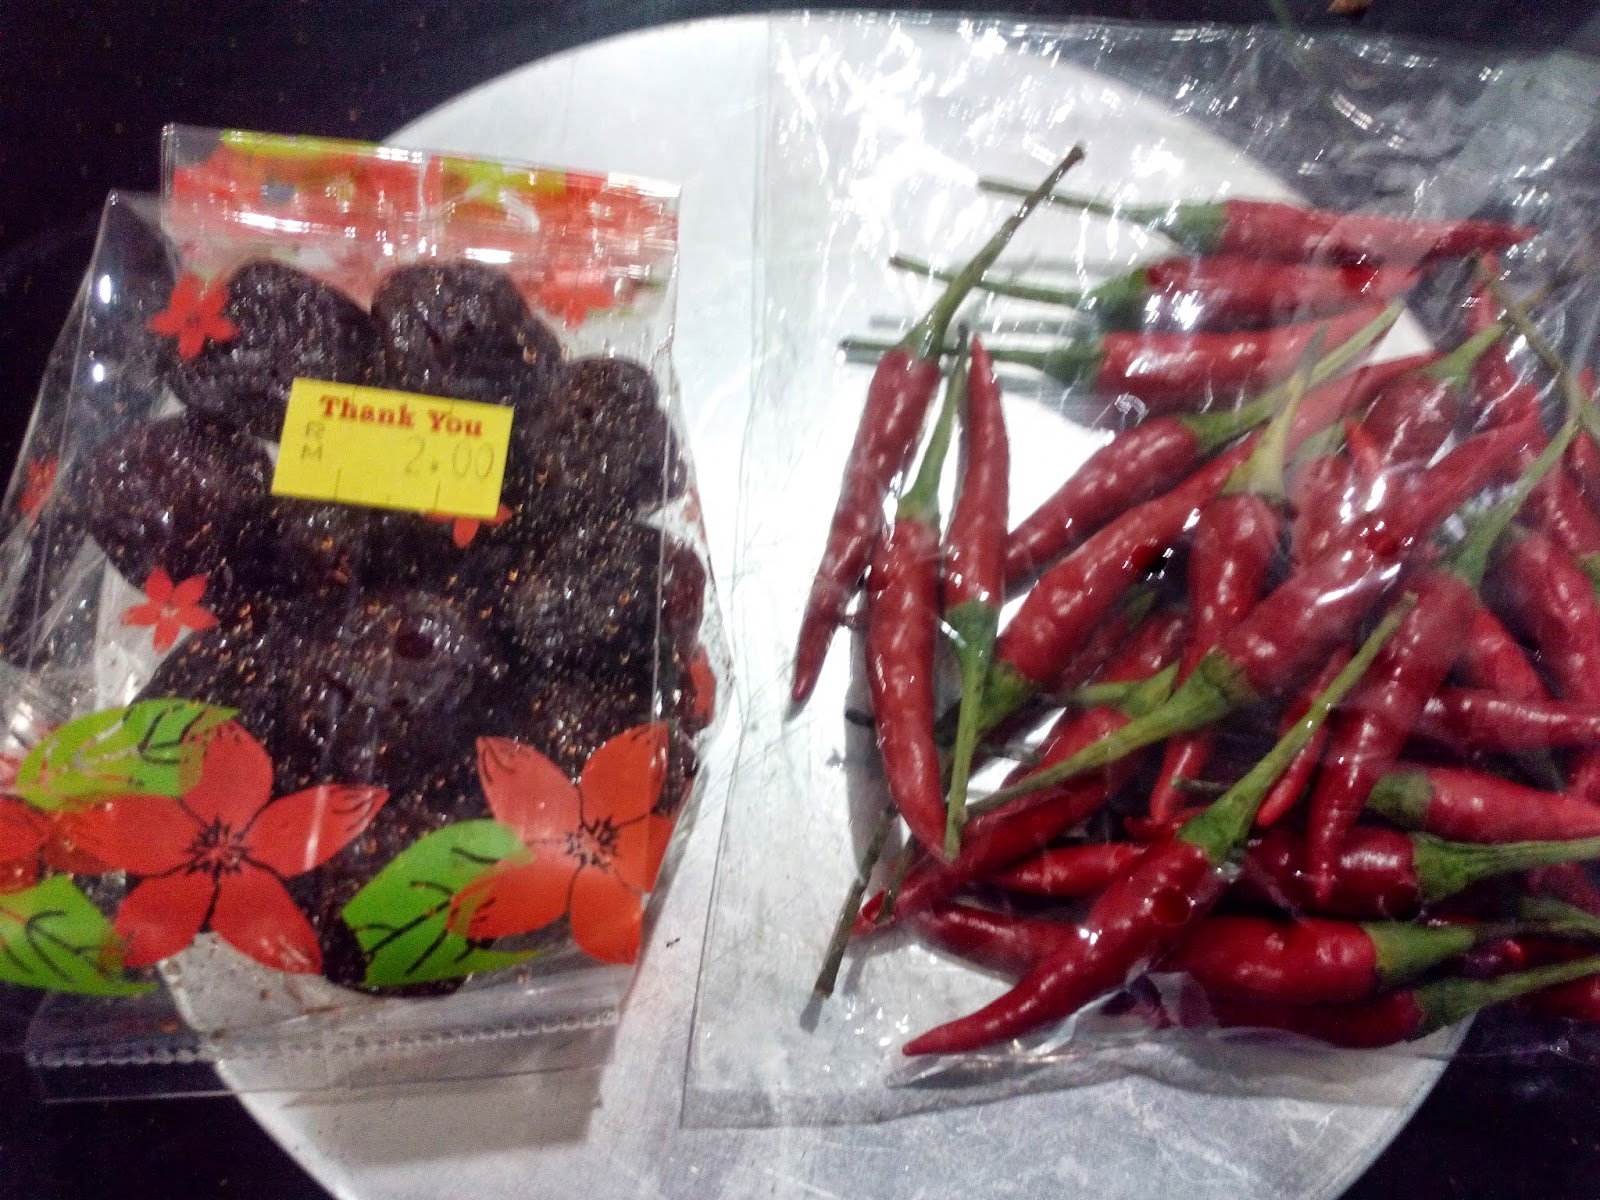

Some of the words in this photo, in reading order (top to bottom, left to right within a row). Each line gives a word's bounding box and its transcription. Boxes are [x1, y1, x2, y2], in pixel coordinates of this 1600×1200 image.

[320, 395, 414, 428] Thank
[428, 408, 482, 437] You
[404, 436, 495, 479] 2.00
